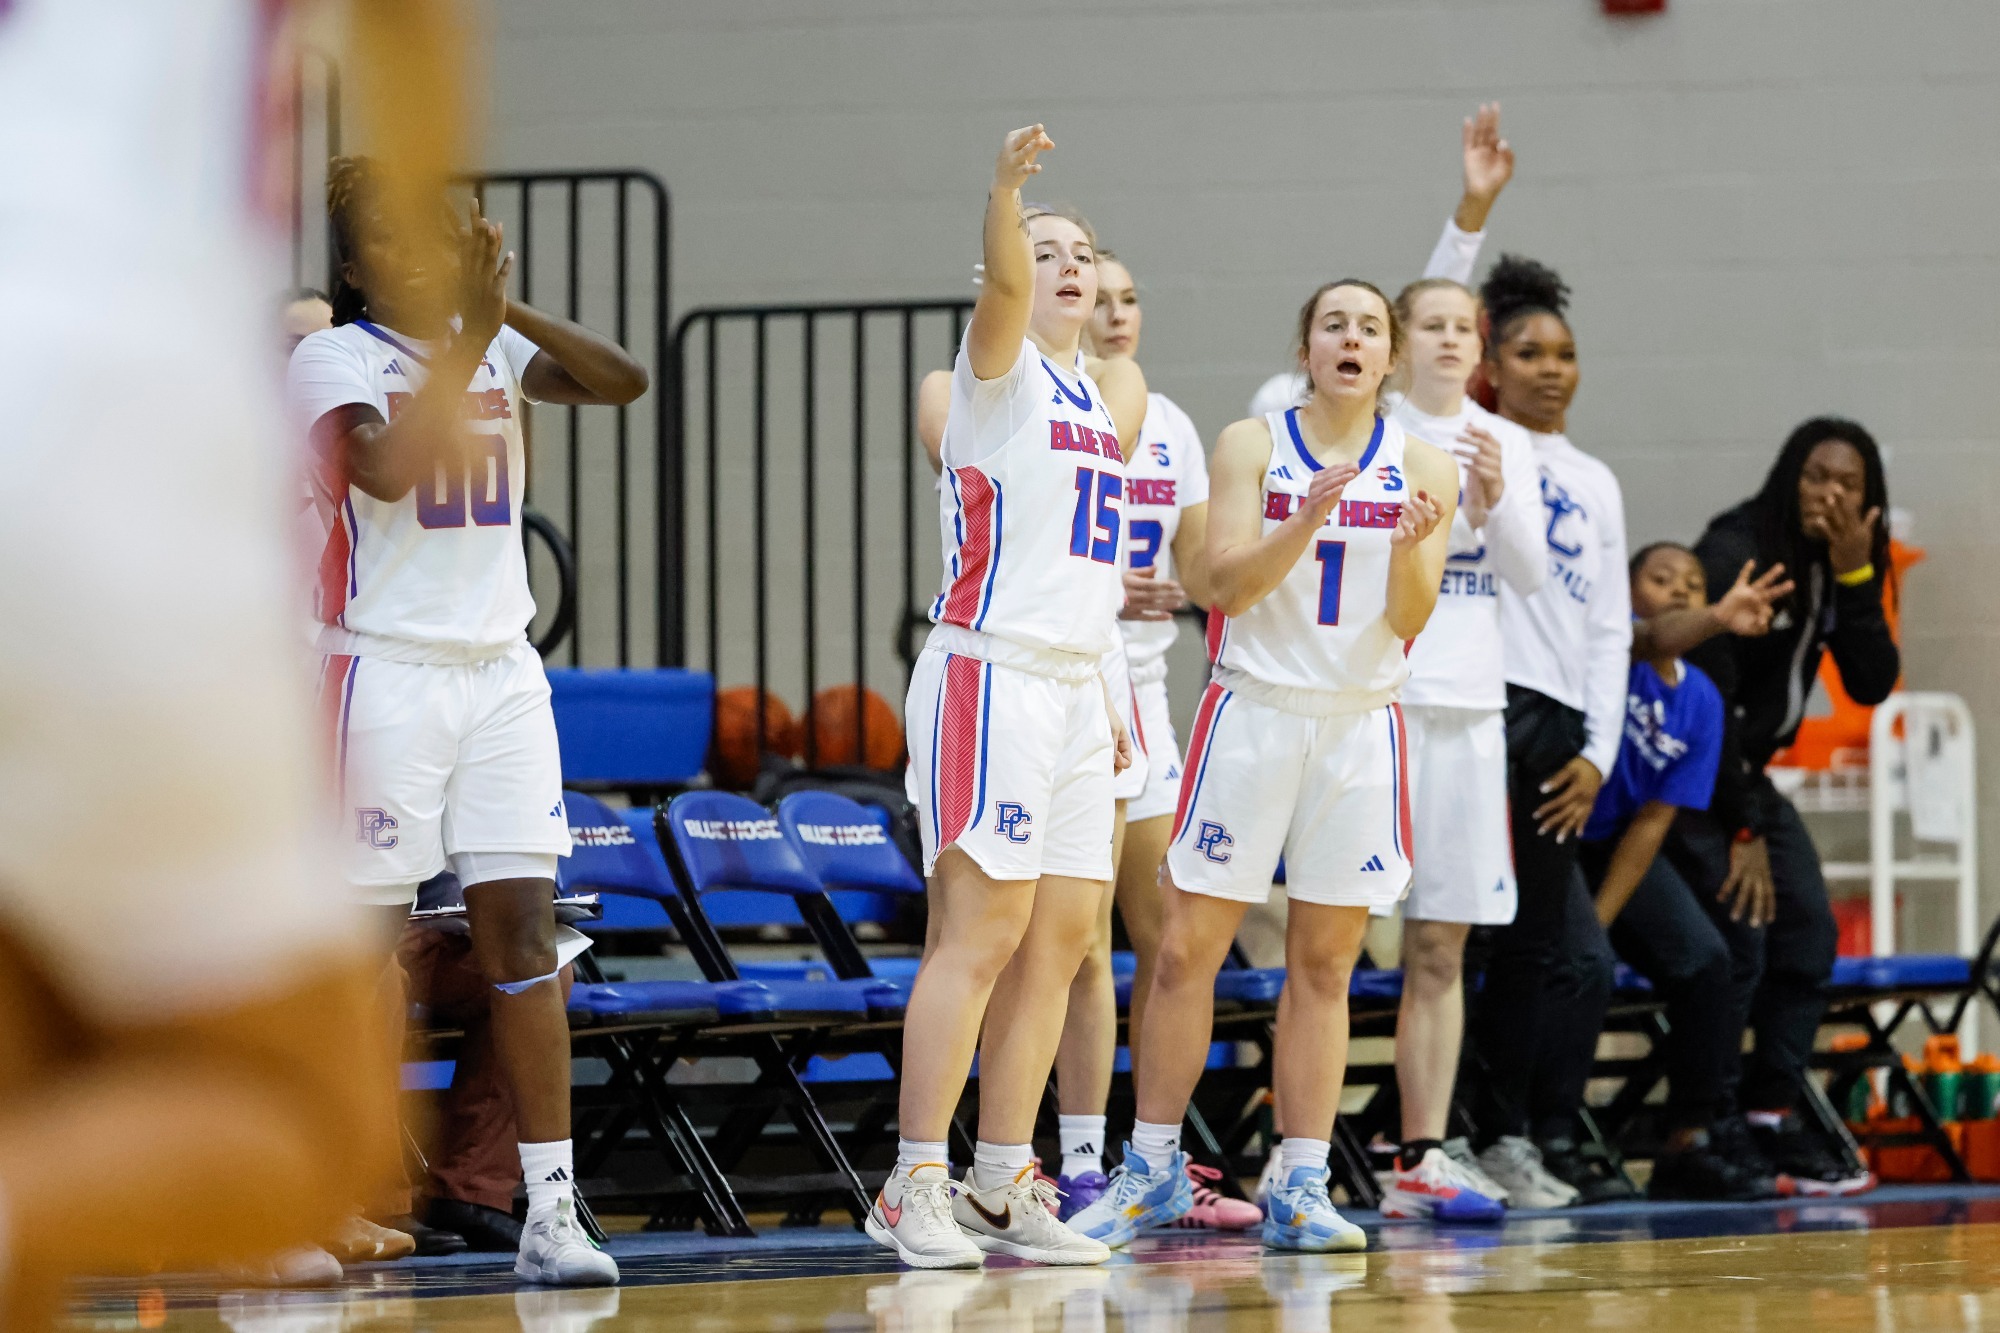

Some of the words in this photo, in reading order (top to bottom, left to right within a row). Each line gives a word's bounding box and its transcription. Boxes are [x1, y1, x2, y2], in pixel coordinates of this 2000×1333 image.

[1048, 419, 1100, 456] BLUE
[1069, 466, 1123, 566] 15
[1315, 539, 1346, 627] 1
[355, 807, 399, 850] PC
[584, 825, 636, 847] HOSE
[684, 819, 728, 840] BLUE
[727, 820, 784, 841] HOSE
[836, 824, 888, 846] HOSE
[995, 800, 1033, 845] PC
[1193, 818, 1236, 865] PC
